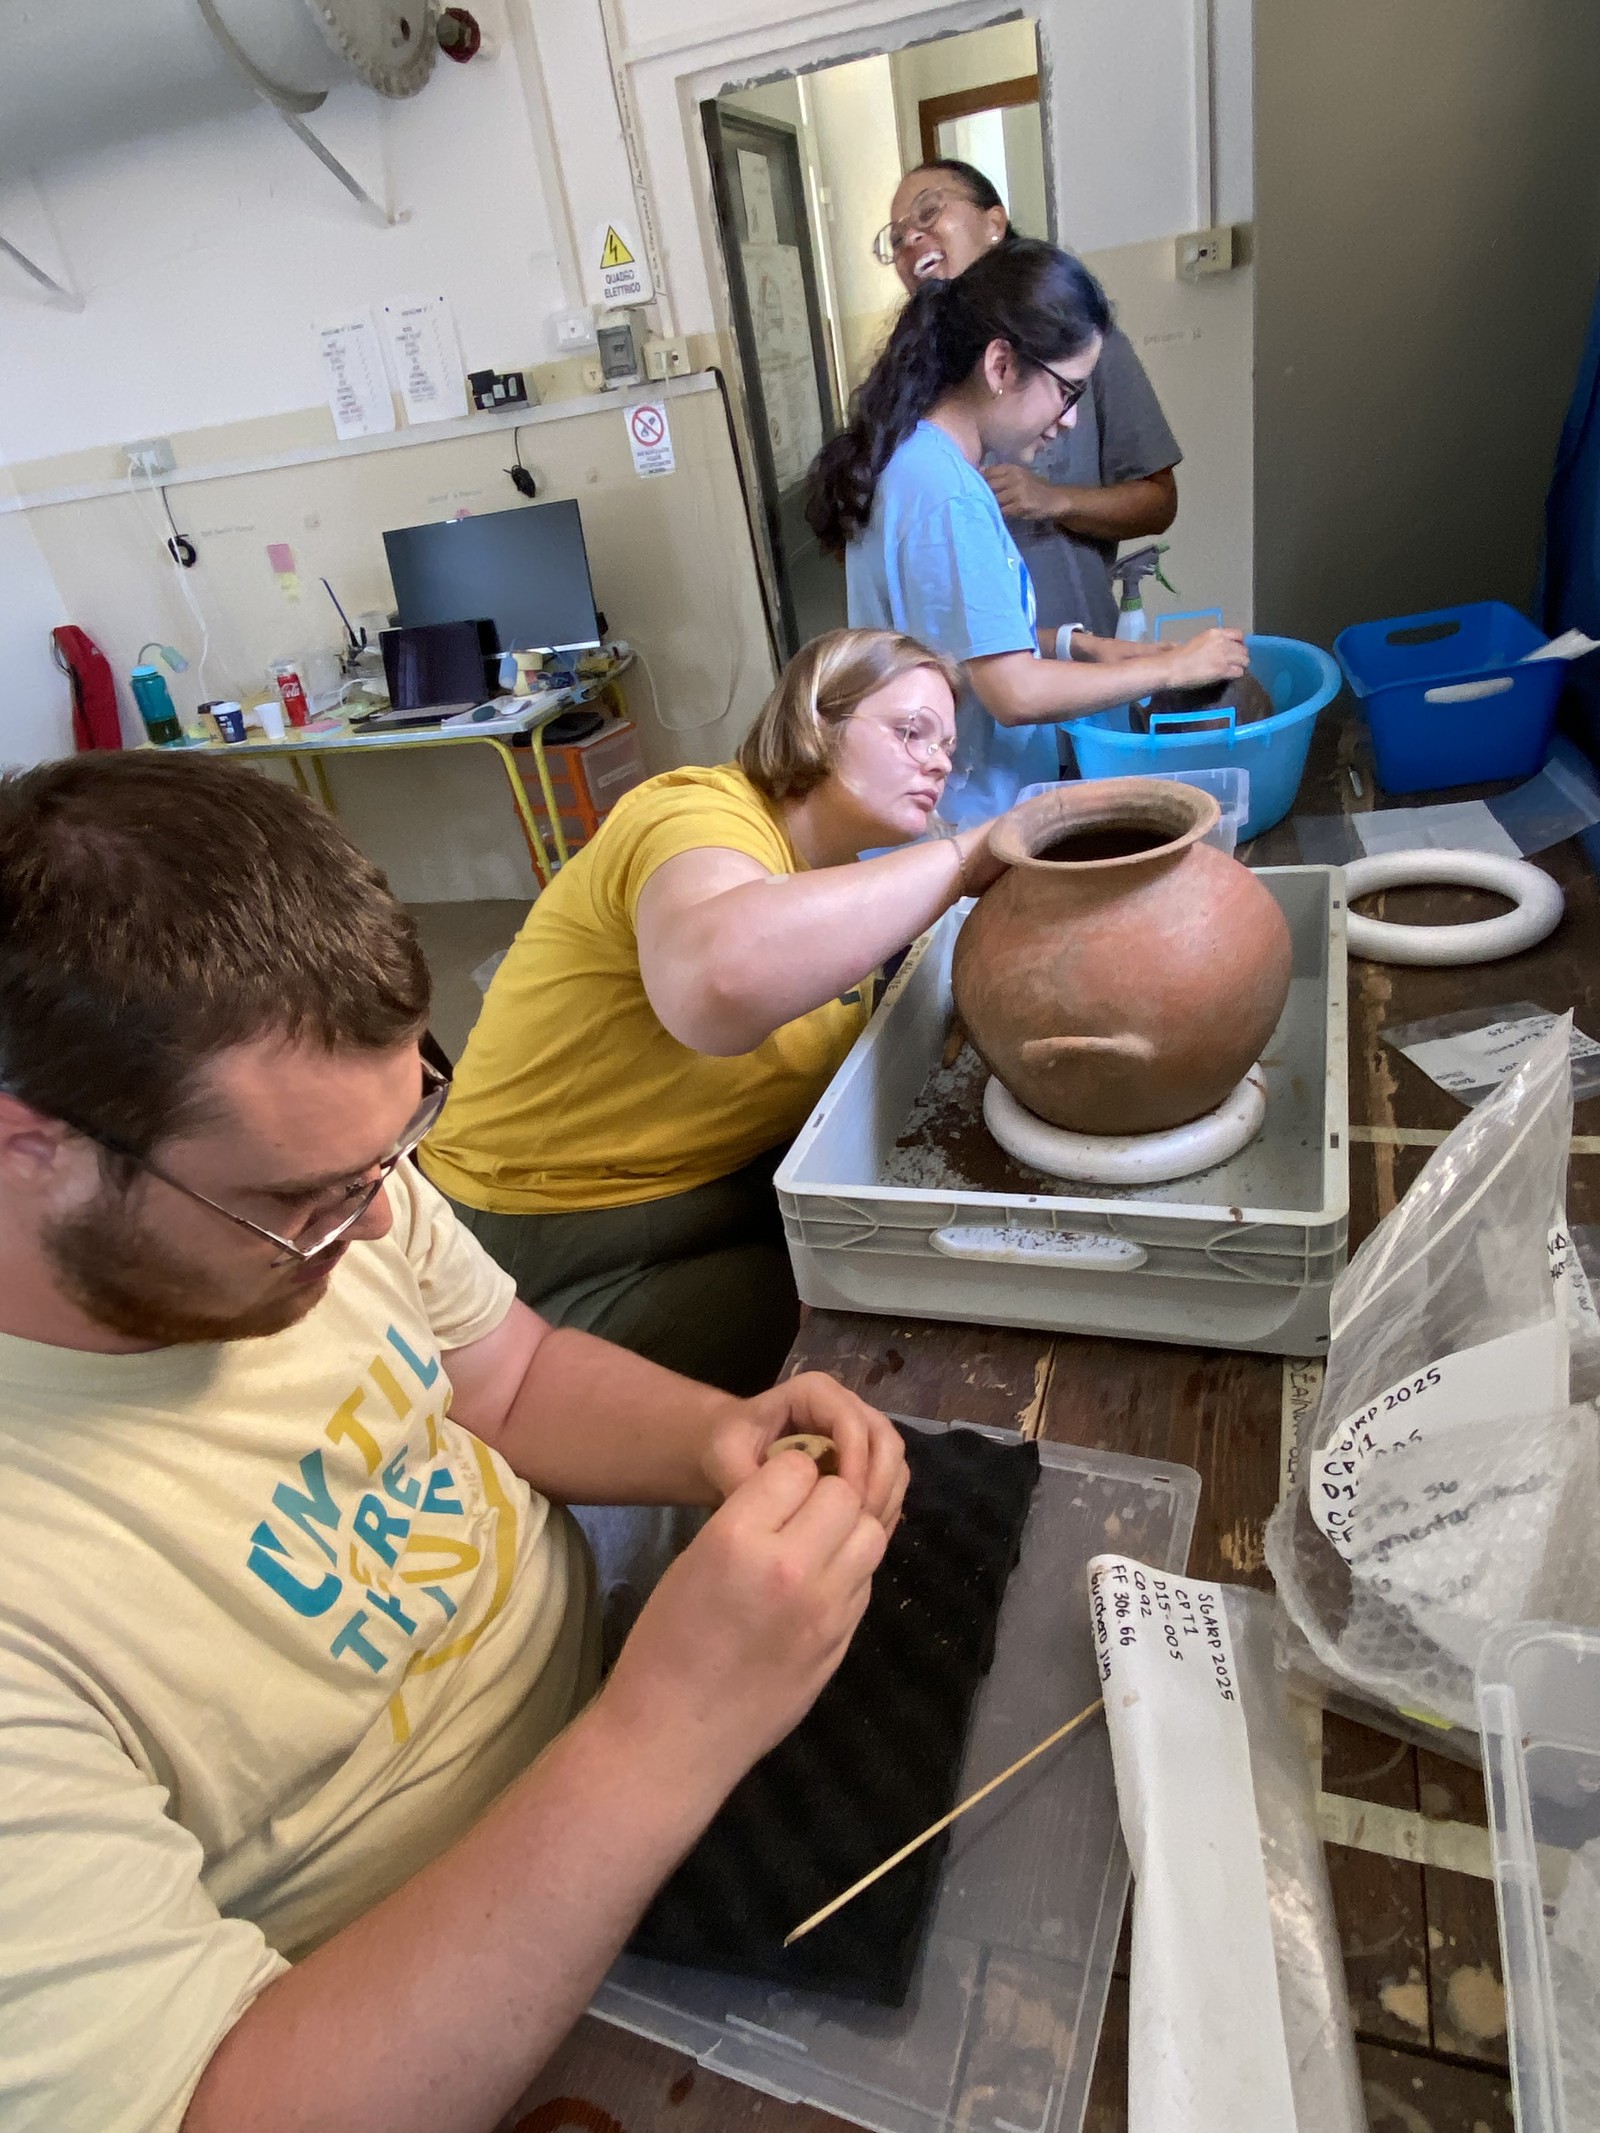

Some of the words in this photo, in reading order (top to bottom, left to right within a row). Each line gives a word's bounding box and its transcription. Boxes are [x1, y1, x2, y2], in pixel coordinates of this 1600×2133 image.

[604, 283, 641, 298] ELETTRICO
[607, 269, 635, 284] QUADRO
[1384, 1367, 1441, 1411] 2025
[246, 1324, 439, 1619] UNTIL
[1153, 1579, 1184, 1662] D15-005
[1198, 1592, 1222, 1649] SGARP
[1212, 1653, 1236, 1702] 2025
